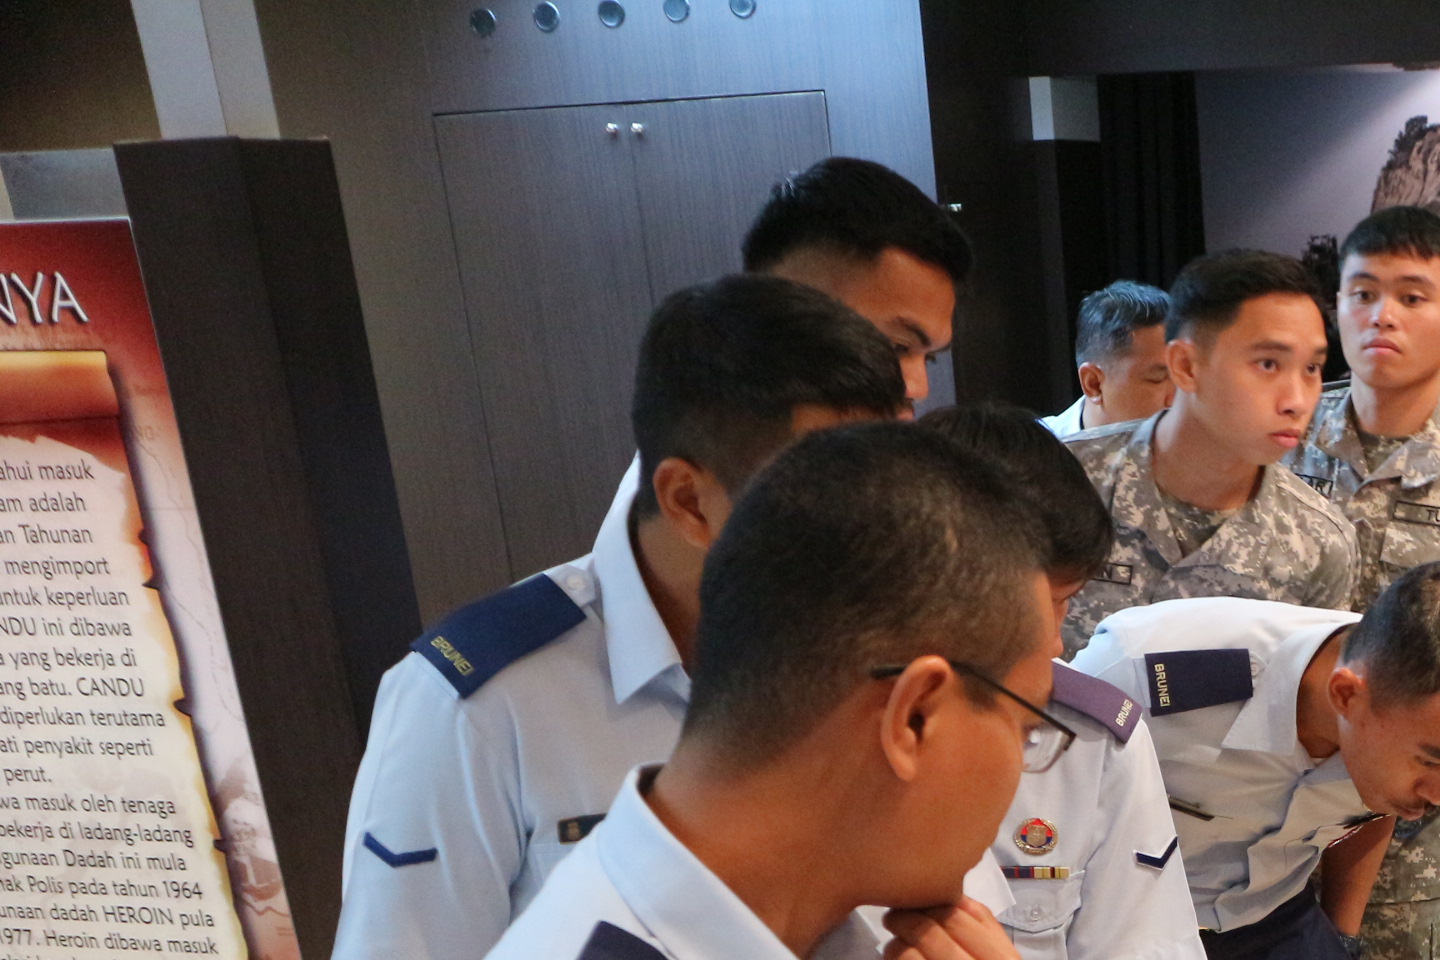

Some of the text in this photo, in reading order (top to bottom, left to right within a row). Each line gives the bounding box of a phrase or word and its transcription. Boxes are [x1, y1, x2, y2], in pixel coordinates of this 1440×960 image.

[38, 459, 95, 481] masuk
[29, 491, 87, 513] adalah
[18, 523, 93, 545] Tahunan
[5, 556, 111, 581] mengimport
[44, 586, 130, 611] keperluan
[42, 618, 65, 636] ini
[69, 616, 133, 637] dibawa
[9, 652, 51, 672] yang
[53, 647, 116, 671] bekerja
[120, 648, 137, 667] di
[430, 635, 475, 676] BRUNEI
[28, 677, 73, 697] batu.
[76, 677, 145, 698] CANDU
[1154, 663, 1171, 707] BRUNEI
[0, 706, 166, 730] diperlukan terutama
[1115, 698, 1134, 728] BRUNEI
[23, 736, 95, 760] penyakit
[99, 738, 155, 761] seperti
[4, 766, 53, 787] perut.
[24, 793, 77, 813] masuk
[82, 793, 118, 813] oleh
[121, 797, 176, 819] tenaga
[58, 821, 75, 839] di
[78, 822, 194, 848] ladang-ladang
[0, 849, 187, 871] gunaan Dadah ini mula
[26, 875, 63, 894] Polis
[68, 878, 108, 899] pada
[112, 879, 159, 899] tahun
[162, 880, 204, 900] 1964
[50, 904, 99, 923] dadah
[102, 905, 174, 926] HEROIN
[179, 910, 215, 930] pula
[43, 929, 99, 949] Heroin
[103, 933, 163, 952] dibawa
[167, 937, 219, 955] masuk
